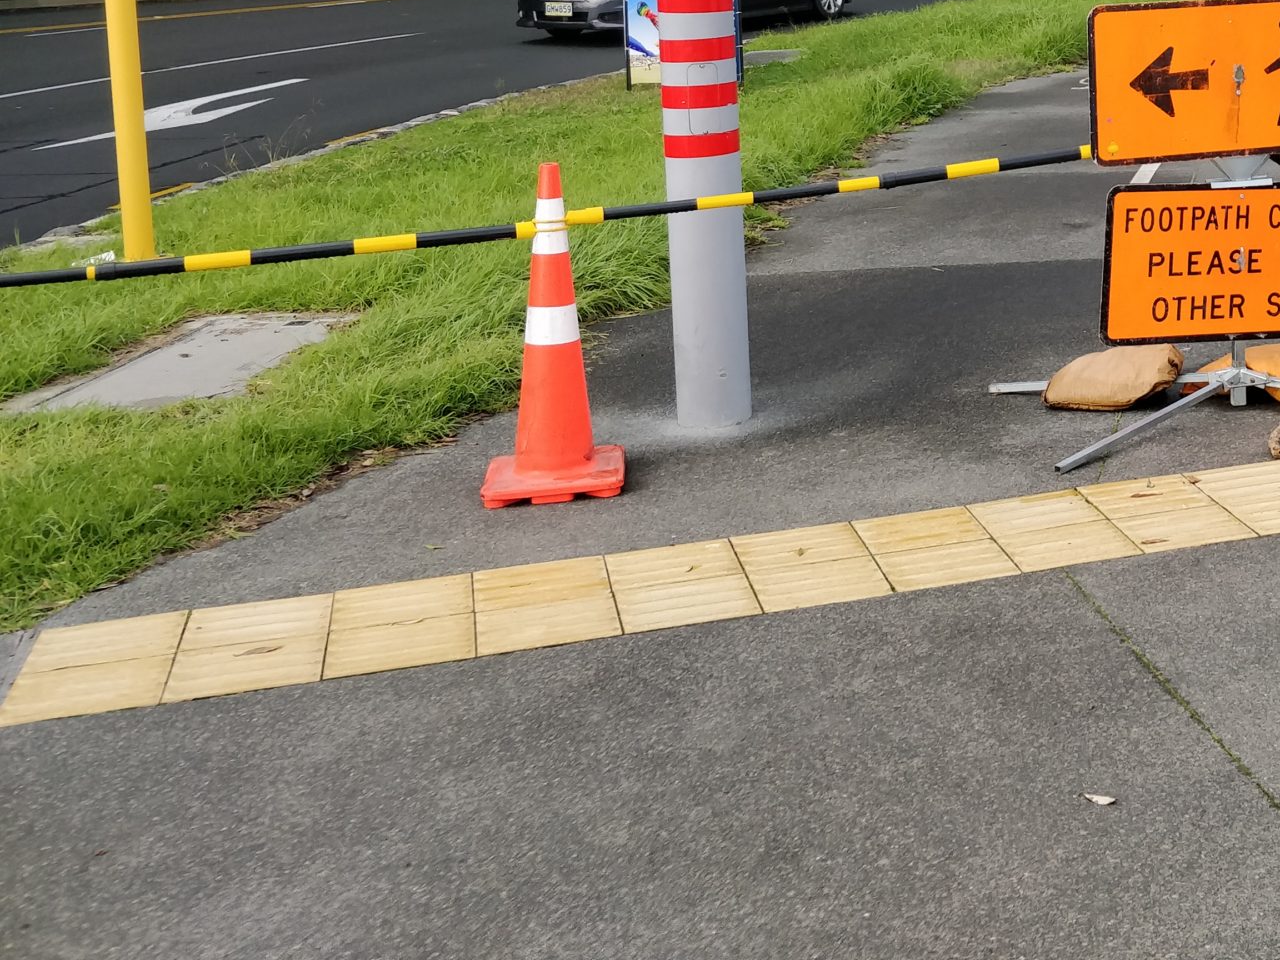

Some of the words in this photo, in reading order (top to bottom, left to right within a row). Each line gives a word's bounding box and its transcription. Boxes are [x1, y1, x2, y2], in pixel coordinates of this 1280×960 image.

[1125, 205, 1250, 233] FOOTPATH
[1148, 249, 1262, 277] PLEASE
[1152, 294, 1246, 322] OTHER
